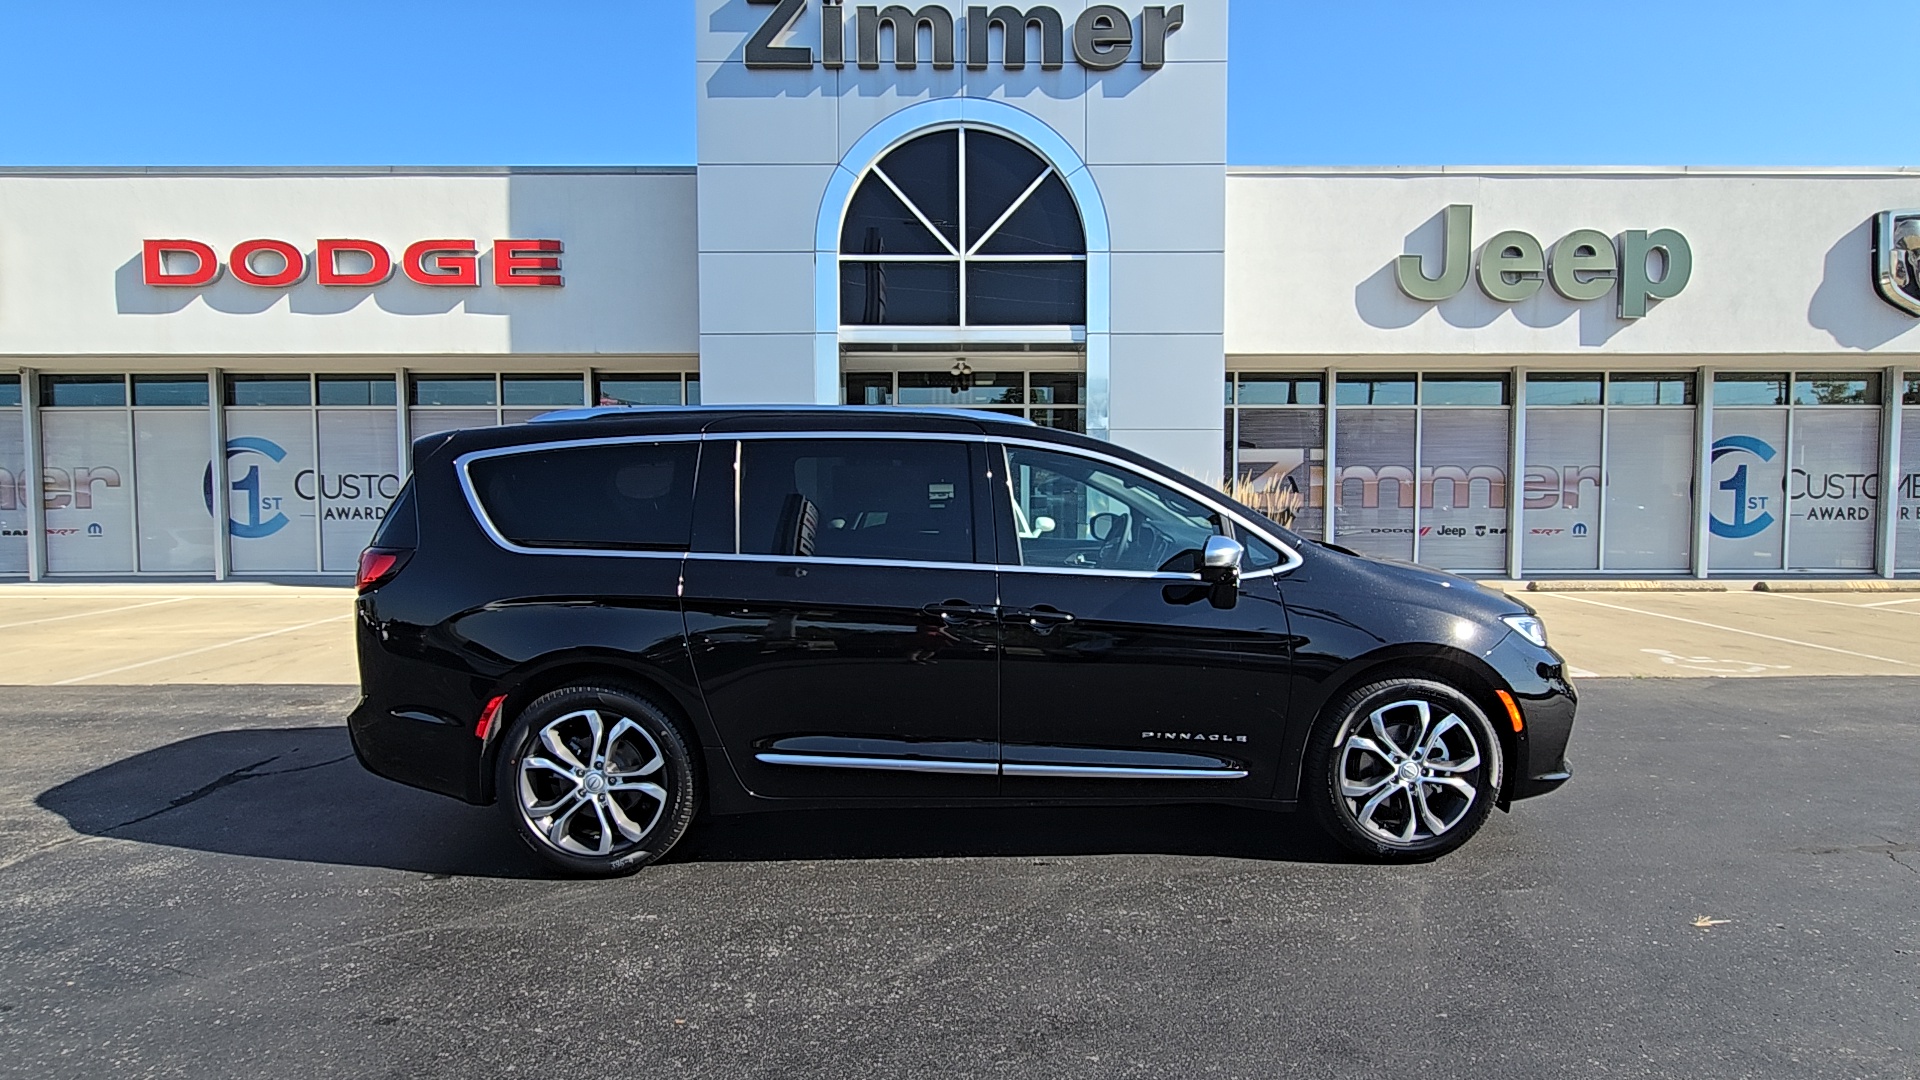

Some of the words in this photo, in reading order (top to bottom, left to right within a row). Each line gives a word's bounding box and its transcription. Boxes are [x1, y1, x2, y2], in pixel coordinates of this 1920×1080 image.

[743, 0, 1184, 70] Zimmer
[142, 238, 566, 288] DODGE
[1393, 203, 1693, 319] Jeep
[0, 466, 121, 510] er
[1437, 525, 1467, 538] Jeep
[1141, 731, 1248, 743] PINNACLE
